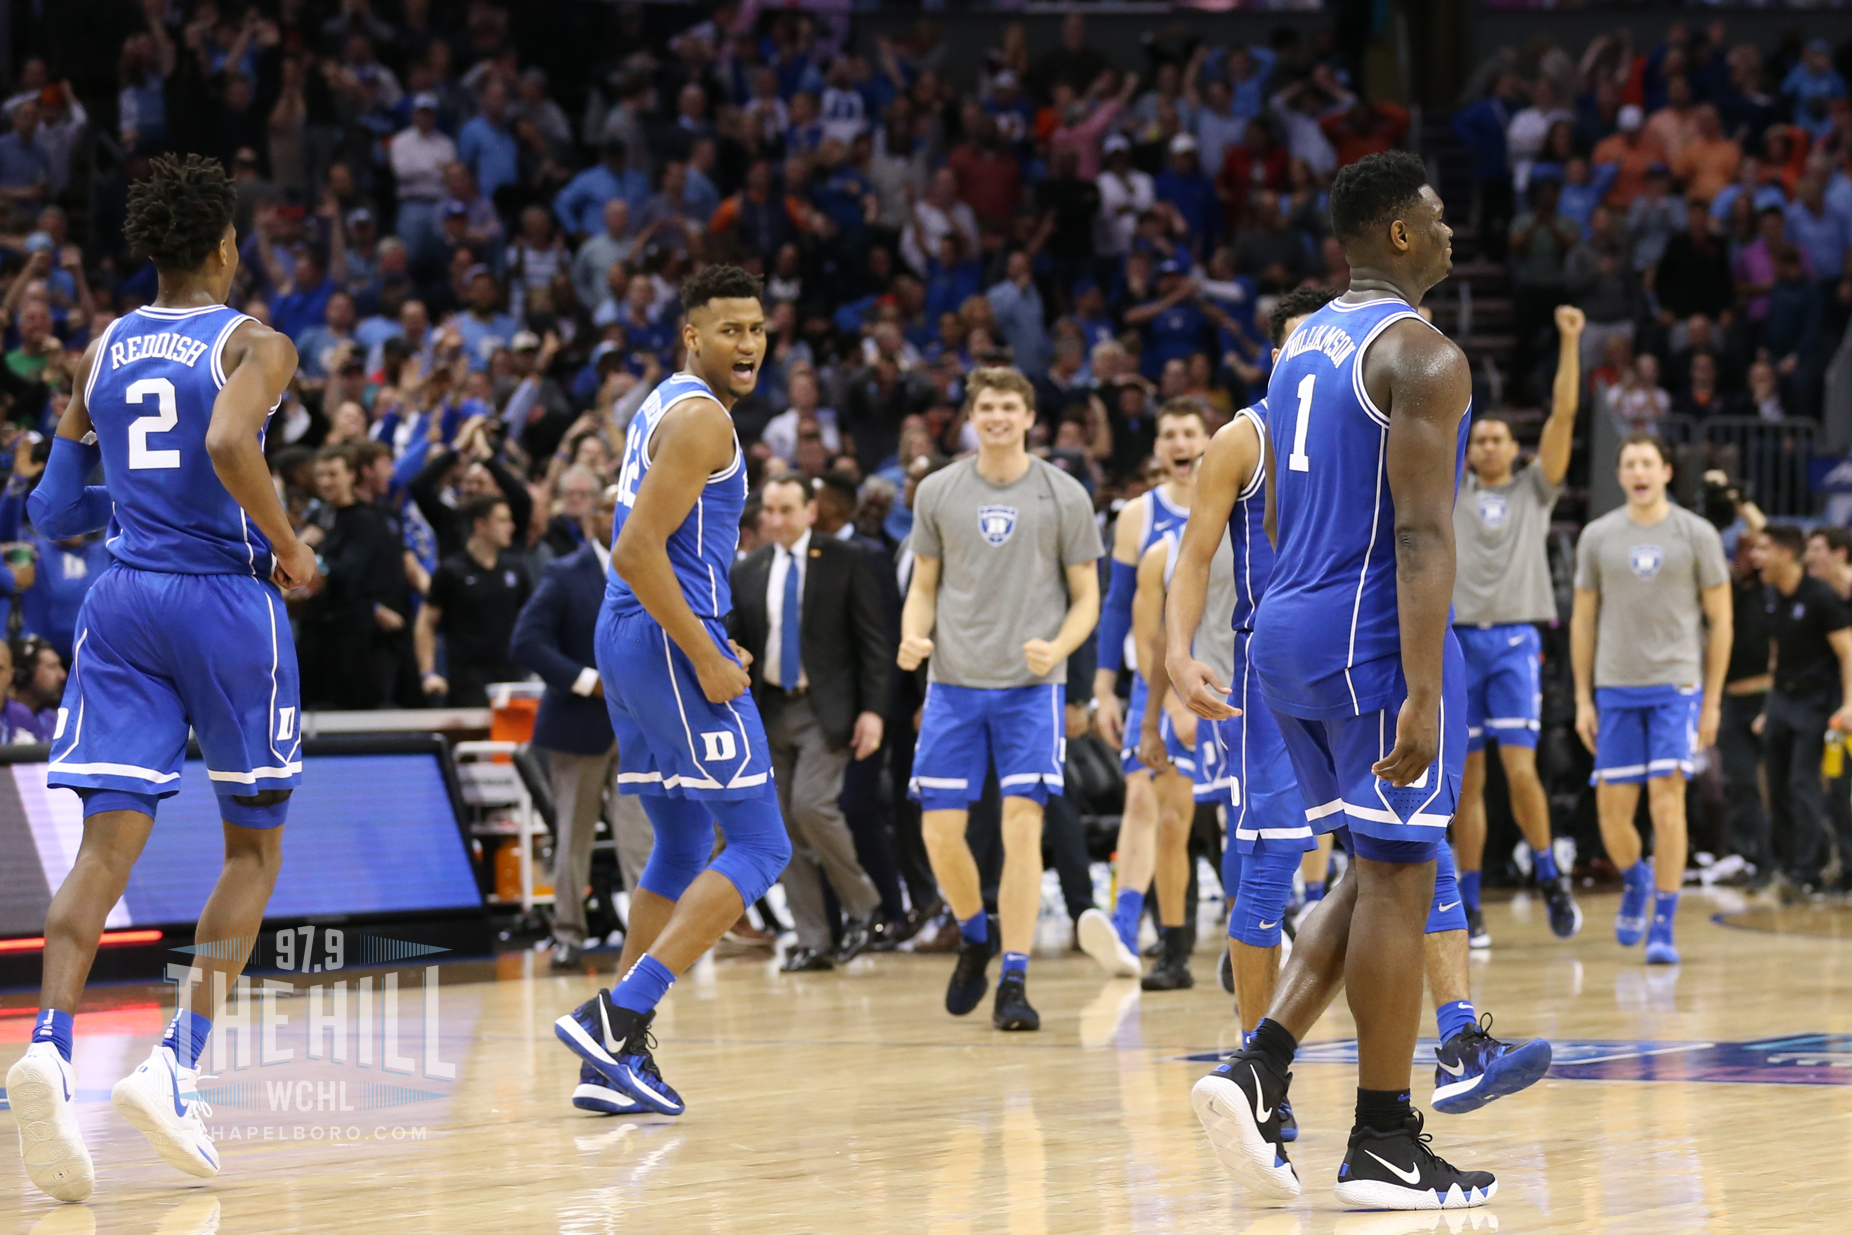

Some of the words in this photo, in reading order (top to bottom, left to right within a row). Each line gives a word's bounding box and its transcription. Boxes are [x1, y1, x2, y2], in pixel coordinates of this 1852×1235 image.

[111, 332, 208, 370] REDDISH
[1285, 324, 1357, 369] WILLIAMSON
[126, 377, 181, 470] 2
[1289, 373, 1317, 472] 1
[617, 423, 642, 509] 12
[277, 706, 296, 741] D
[700, 731, 737, 762] D
